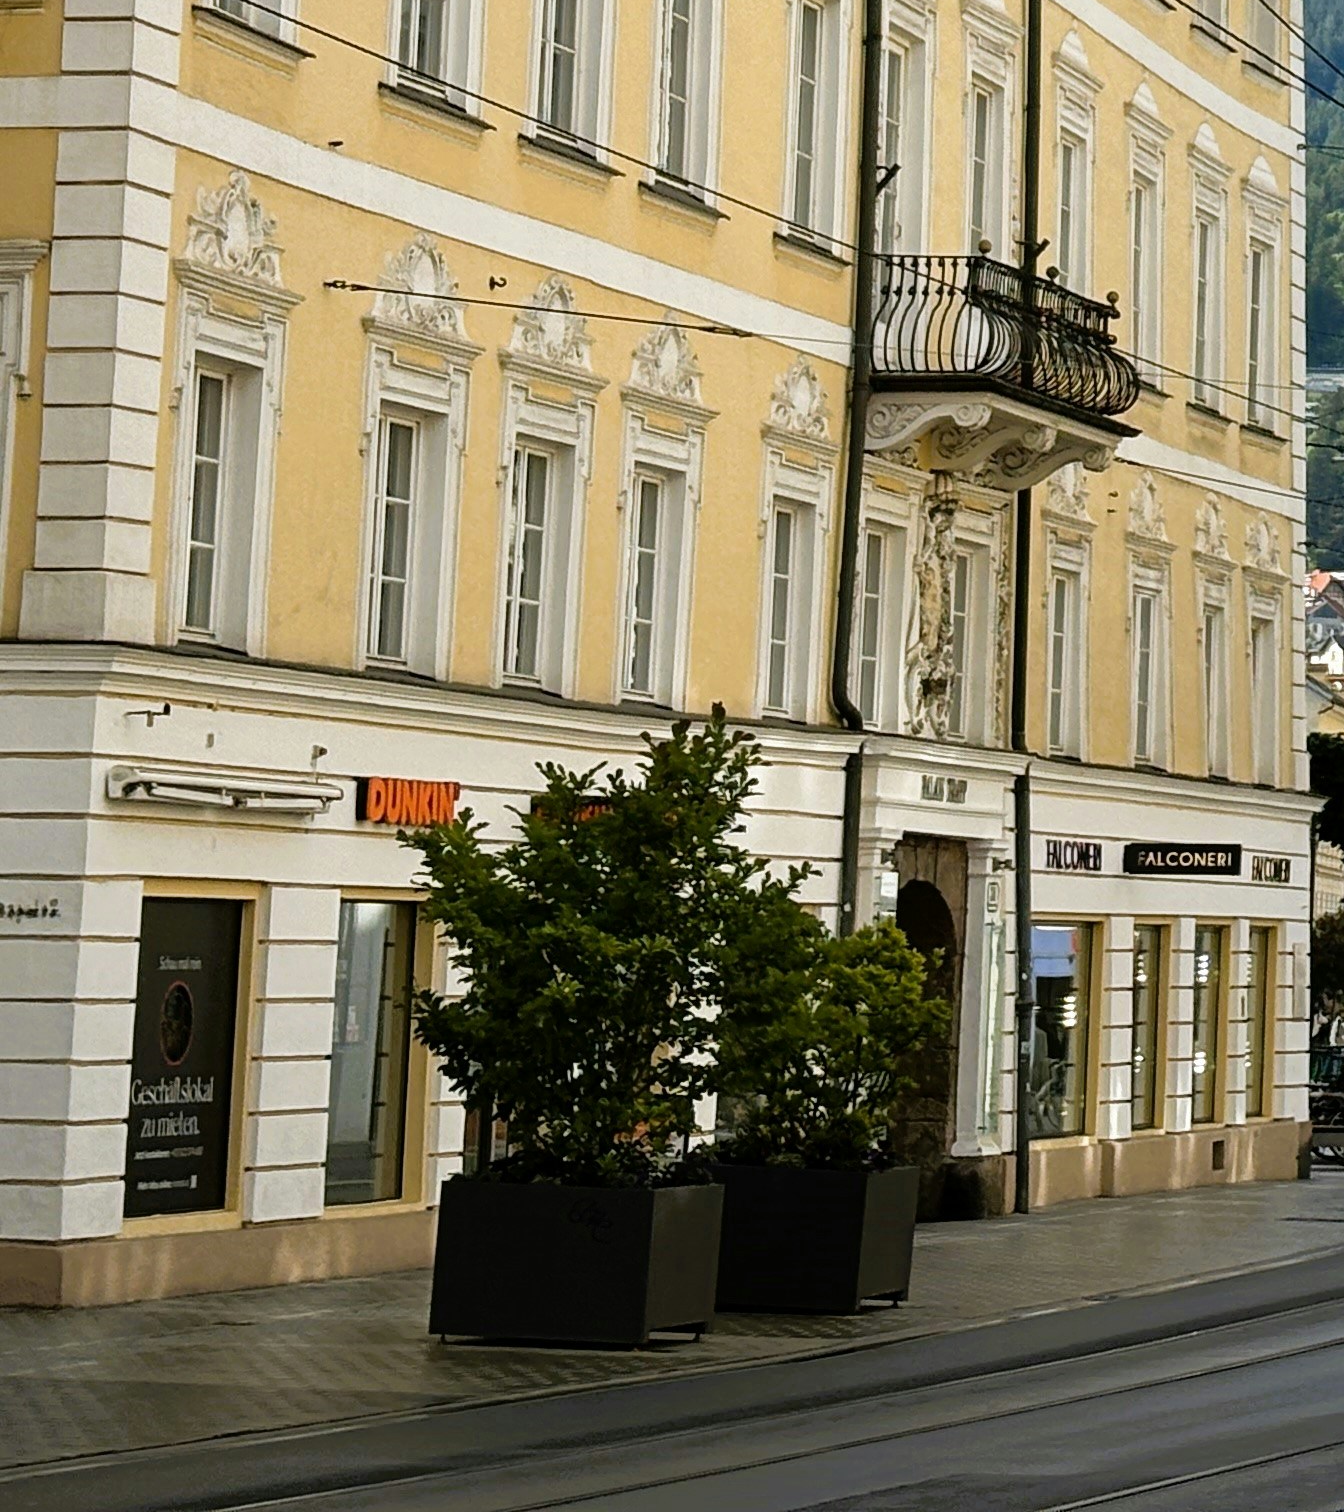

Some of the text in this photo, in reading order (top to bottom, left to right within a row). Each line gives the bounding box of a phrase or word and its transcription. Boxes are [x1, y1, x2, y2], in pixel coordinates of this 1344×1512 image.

[1046, 839, 1103, 872] FALCONERI
[1138, 850, 1233, 868] FALCONERI
[140, 1118, 156, 1138] zu
